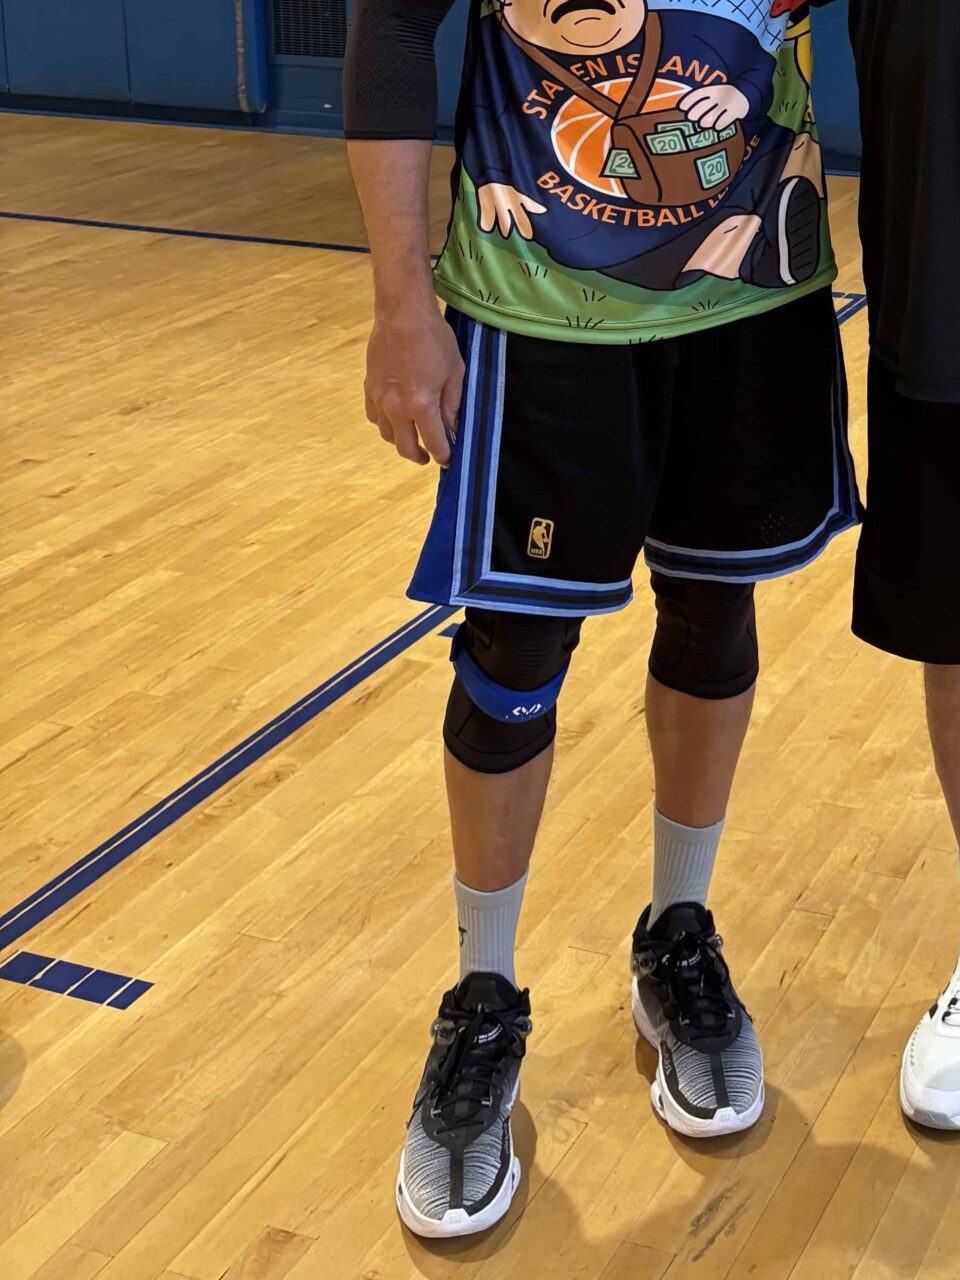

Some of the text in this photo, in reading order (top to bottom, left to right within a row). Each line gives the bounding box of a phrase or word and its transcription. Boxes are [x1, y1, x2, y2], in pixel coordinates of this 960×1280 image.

[522, 53, 728, 120] STAEN ISAND
[657, 139, 677, 152] 20
[707, 160, 723, 177] 20
[536, 170, 704, 227] BASKETBALL
